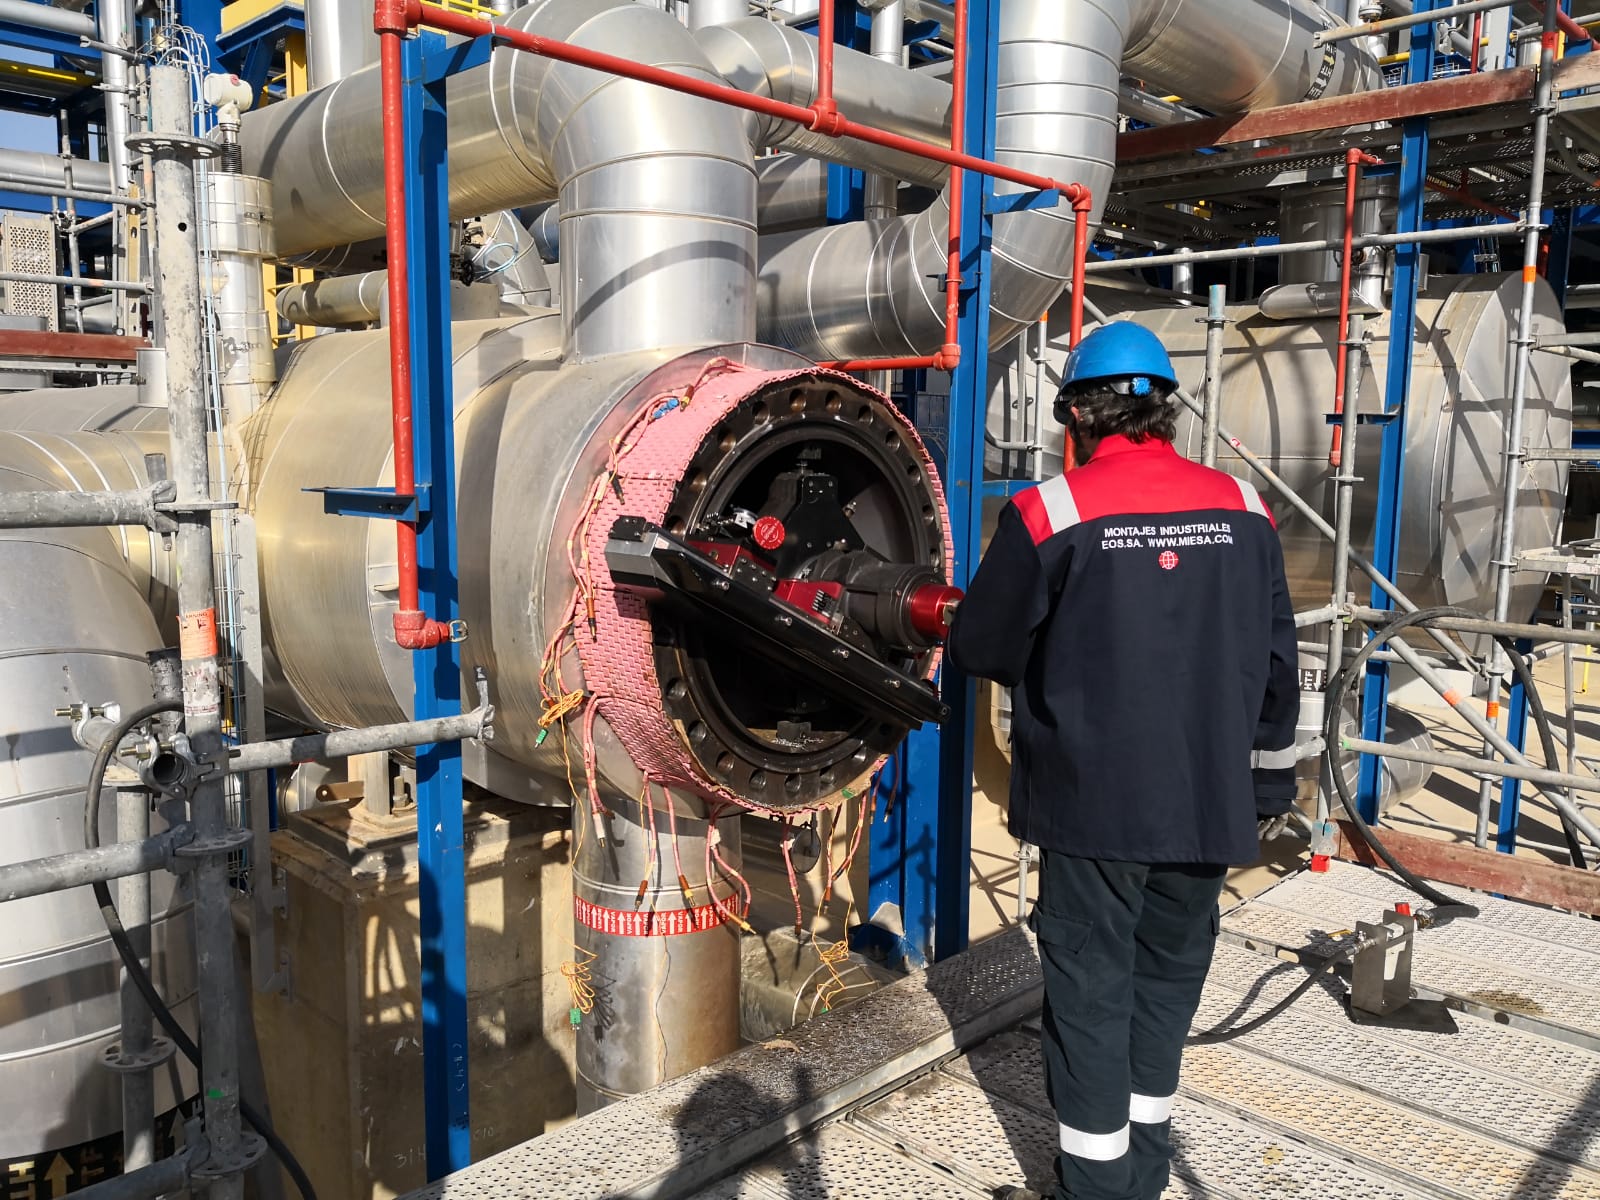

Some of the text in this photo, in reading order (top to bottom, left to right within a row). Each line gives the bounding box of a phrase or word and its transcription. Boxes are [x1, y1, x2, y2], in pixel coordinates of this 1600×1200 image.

[1104, 523, 1231, 538] MONTAJES INDUSTRIALES
[1101, 534, 1233, 550] EOS.SA. WWW.MIESA.COM
[1304, 670, 1313, 690] HTF
